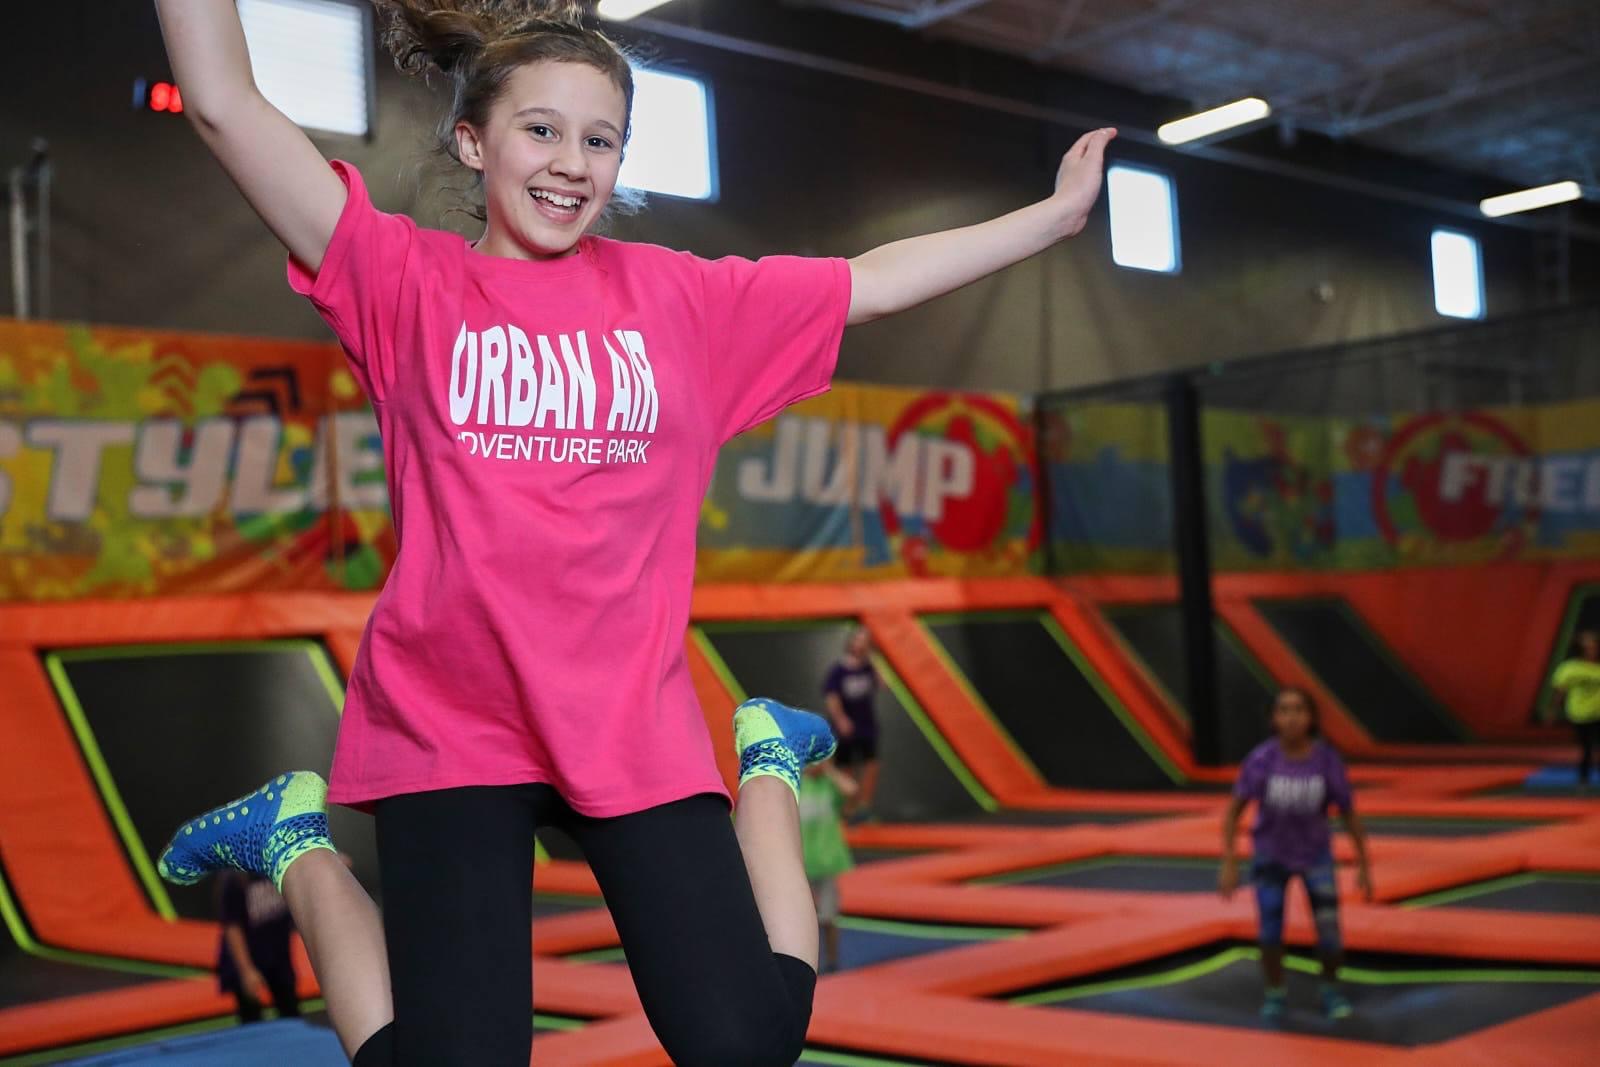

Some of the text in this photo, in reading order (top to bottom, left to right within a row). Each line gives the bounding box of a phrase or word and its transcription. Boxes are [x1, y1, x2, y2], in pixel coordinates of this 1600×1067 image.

[449, 320, 659, 434] URBAN AIR
[0, 411, 388, 522] TYLE
[457, 432, 651, 465] DVENTURE PARK
[738, 413, 975, 523] JUMP
